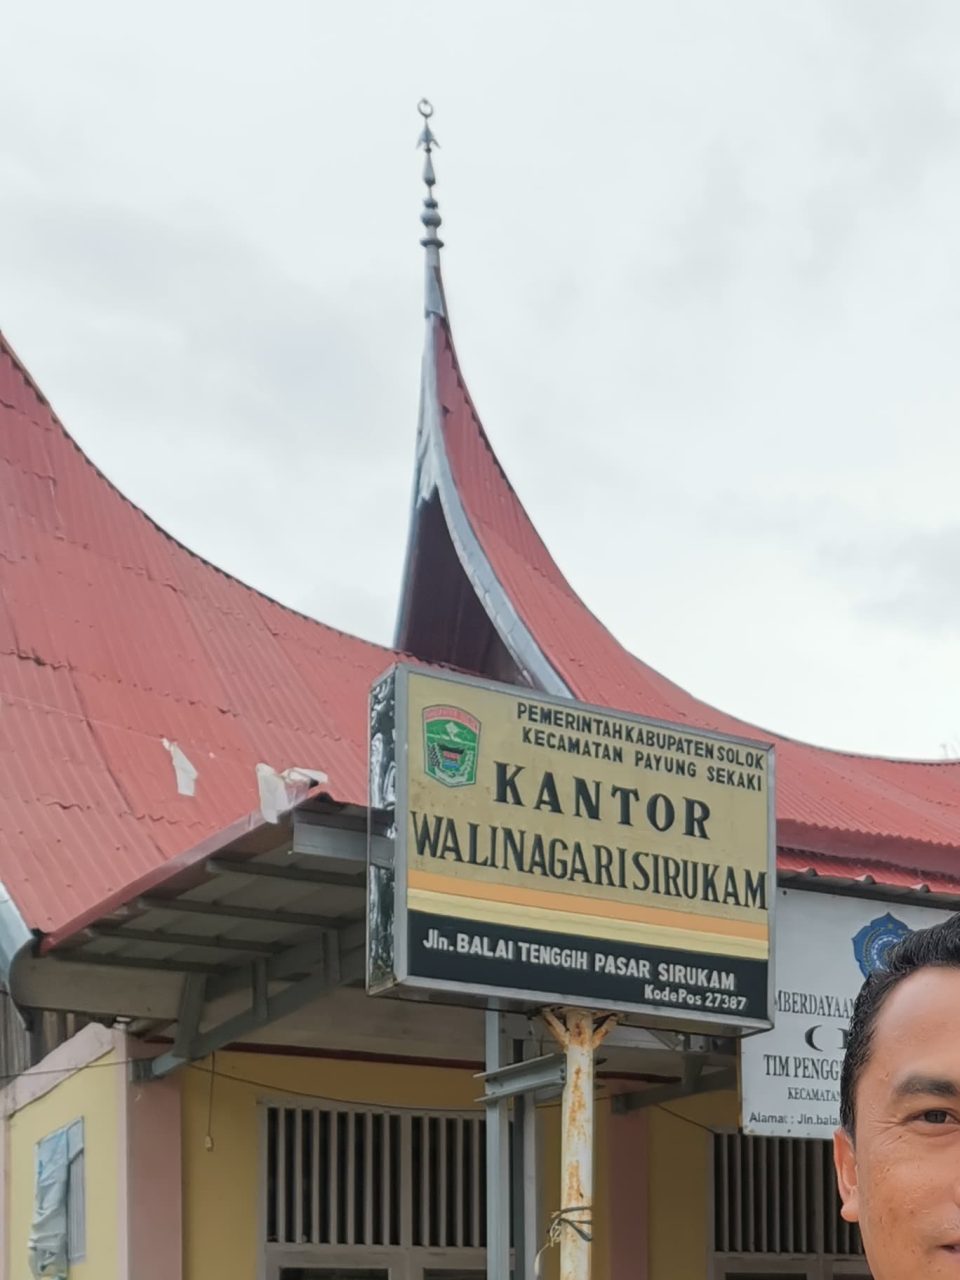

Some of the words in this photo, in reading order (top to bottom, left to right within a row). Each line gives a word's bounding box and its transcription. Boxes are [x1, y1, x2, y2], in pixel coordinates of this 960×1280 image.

[522, 727, 623, 763] KECAMATAN
[634, 751, 697, 778] PAYUNG
[706, 765, 762, 792] SEKAKI
[716, 746, 764, 771] SOLOK
[493, 760, 711, 840] KANTOR
[456, 933, 514, 960] BALAI
[517, 941, 588, 970] TENGGIH
[594, 953, 650, 978] PASAR
[658, 963, 735, 990] SIRUKAM
[705, 991, 747, 1011] 27387
[763, 1054, 789, 1076] TIM
[794, 1058, 844, 1081] PENGG
